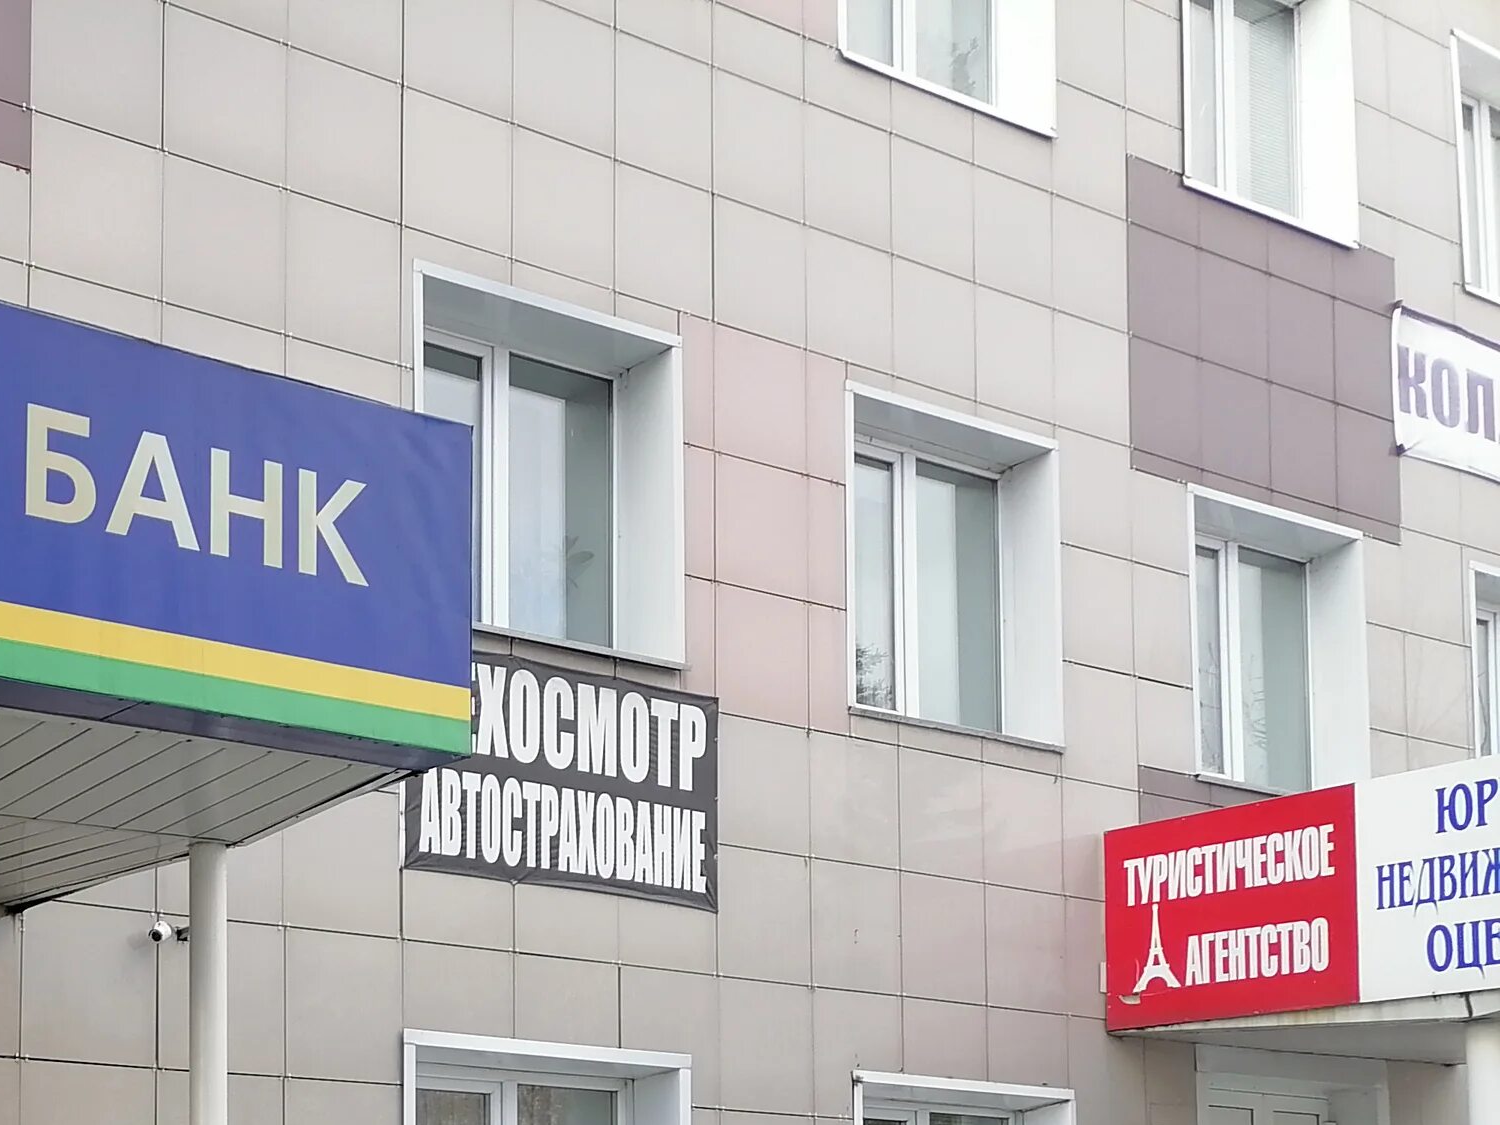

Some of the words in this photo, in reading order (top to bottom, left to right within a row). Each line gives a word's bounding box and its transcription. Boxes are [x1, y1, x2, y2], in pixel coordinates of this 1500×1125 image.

[1397, 343, 1500, 443] КОЛ
[25, 403, 369, 587] БАНК
[472, 661, 707, 792] ХОСМОТР
[419, 767, 707, 894] АВТОСТРАХОВАНИЕ
[1435, 776, 1500, 834] ЮР
[1124, 824, 1336, 906] ТУРИСТИЧЕСКОЕ
[1185, 917, 1329, 987] АГЕНТСТВО
